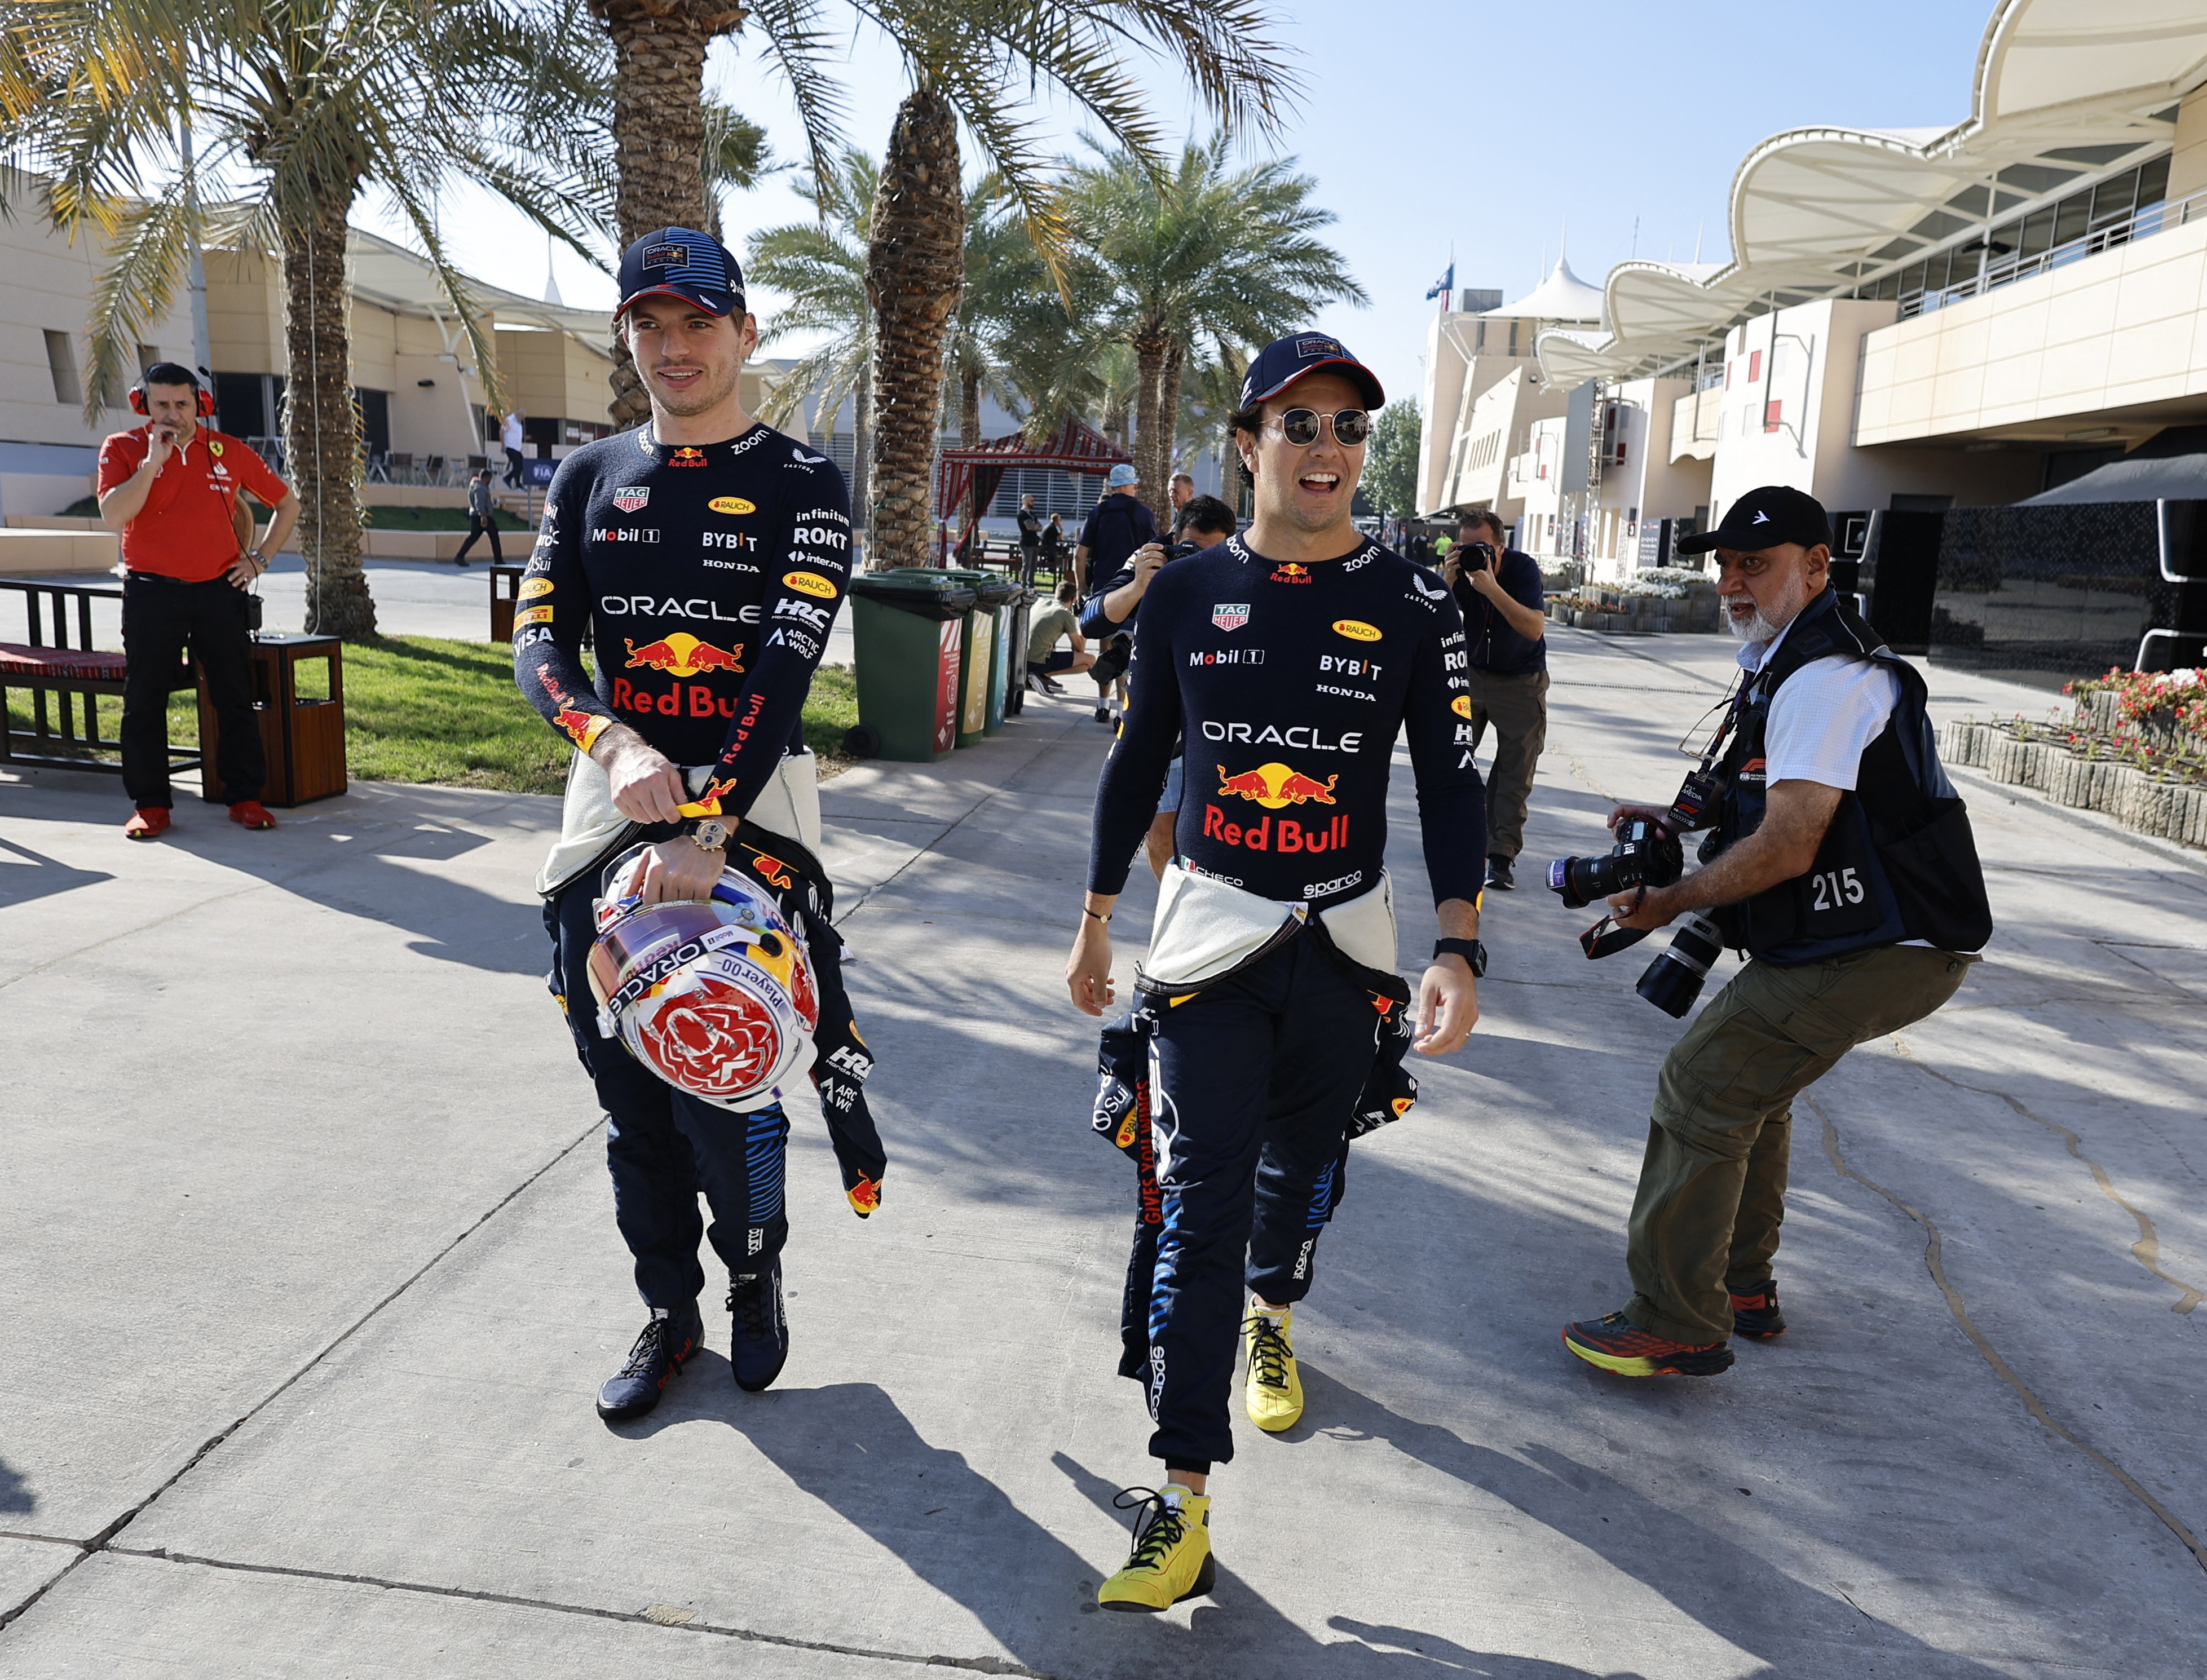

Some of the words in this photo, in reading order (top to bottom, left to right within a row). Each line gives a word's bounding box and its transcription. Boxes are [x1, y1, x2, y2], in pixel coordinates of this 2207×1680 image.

[647, 246, 683, 254] ORACLE
[731, 429, 770, 455] zoom
[668, 458, 688, 467] Red
[688, 458, 708, 467] Bull
[783, 463, 815, 475] CASTORE
[533, 469, 551, 478] FIA
[616, 498, 646, 511] HEUER
[721, 501, 750, 511] RAUCH
[797, 509, 849, 527] infinitum
[592, 528, 639, 542] Mobil
[703, 532, 758, 552] BYBIT
[793, 527, 847, 550] ROKT
[532, 556, 551, 571] Sui
[703, 560, 760, 573] HONDA
[806, 552, 844, 573] inter.mx
[1343, 545, 1380, 572] zoom
[798, 577, 832, 595] RAUCH
[1270, 572, 1290, 583] Red
[1292, 575, 1312, 584] Bull
[601, 595, 762, 624] ORACLE
[1217, 606, 1247, 614] TAG
[1404, 593, 1437, 613] CASTORE
[774, 598, 831, 629] HRC
[1215, 616, 1246, 629] HEUER
[798, 618, 822, 634] RACING
[1346, 625, 1376, 638] RAUCH
[514, 627, 554, 657] VISA
[786, 629, 819, 654] ARCTIC
[789, 639, 814, 660] WOLF
[1190, 650, 1239, 666] Mobil
[1319, 655, 1381, 681] BYBIT
[612, 677, 681, 716] Red
[689, 686, 739, 718] Bu
[1316, 684, 1376, 701] HONDA
[722, 729, 750, 764] Red
[741, 694, 765, 727] Bull
[1202, 721, 1363, 753] ORACLE
[1681, 790, 1702, 802] MEDIA
[1203, 804, 1270, 851] Red
[1278, 814, 1349, 854] Bull
[1196, 866, 1243, 886] CHECO
[1303, 870, 1362, 899] sparco
[1813, 868, 1864, 911] 215
[716, 930, 734, 942] Mobil
[610, 943, 700, 1014] ORACLE
[743, 971, 783, 1009] Player
[851, 1073, 866, 1084] RAC
[835, 1084, 858, 1102] ARC
[1105, 1085, 1129, 1113] Sui
[1136, 1079, 1151, 1135] WINGS
[1140, 1138, 1154, 1173] YOU
[1142, 1177, 1163, 1225] GIVES
[1150, 1345, 1166, 1421] sparco
